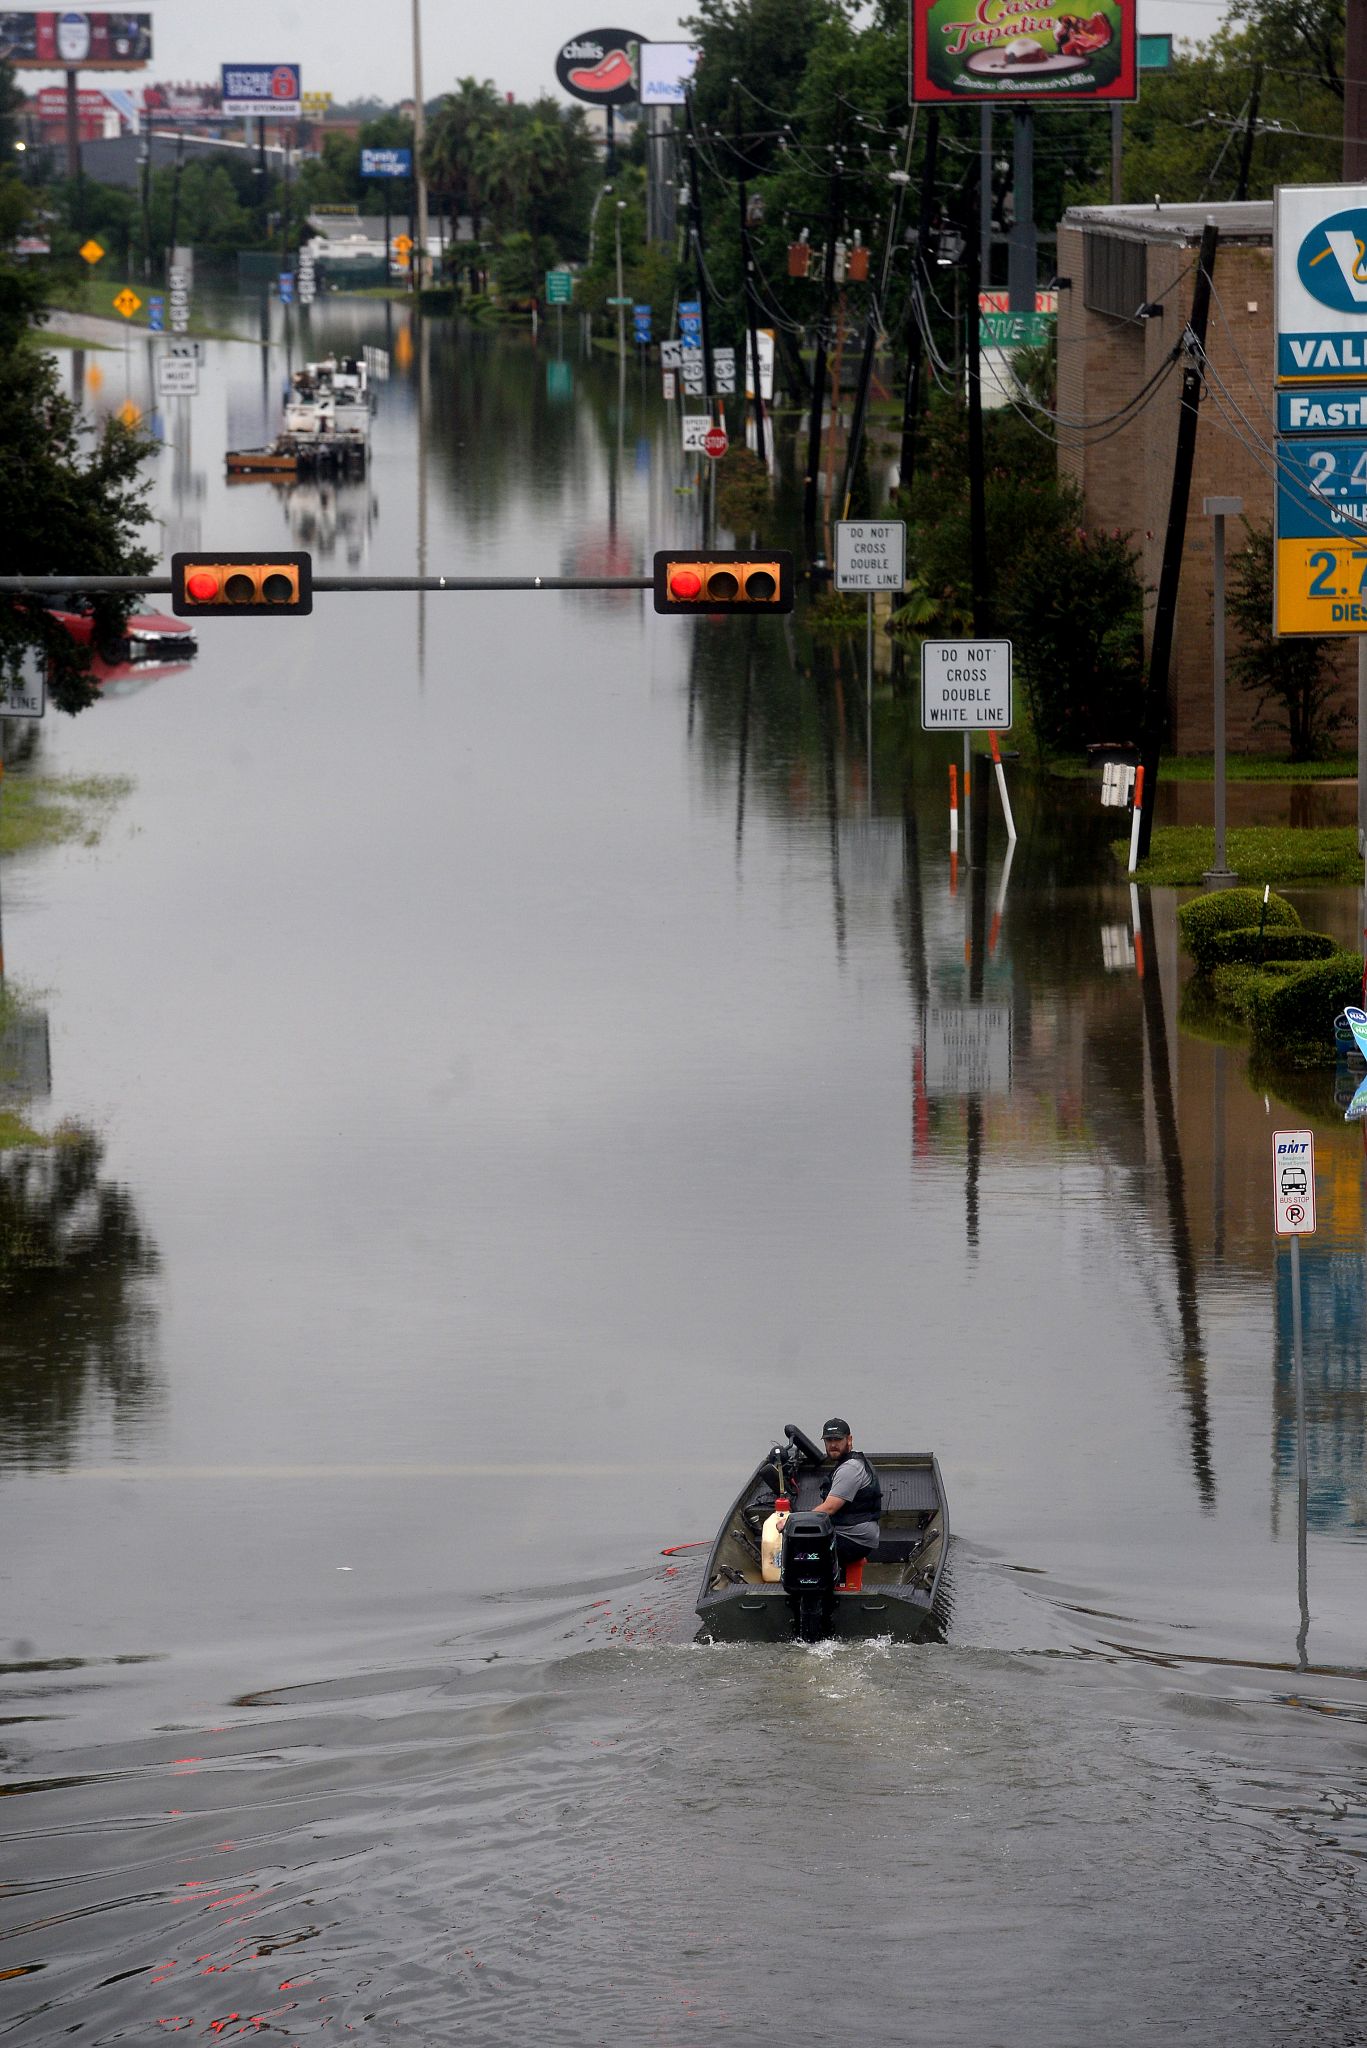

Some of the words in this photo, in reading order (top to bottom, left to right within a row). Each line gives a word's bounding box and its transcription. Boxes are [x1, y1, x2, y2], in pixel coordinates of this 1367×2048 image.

[976, 0, 1055, 24] Casa
[941, 16, 1055, 54] Tapatia
[684, 319, 698, 331] 10
[1289, 339, 1367, 368] VAL
[685, 364, 702, 376] 90
[717, 362, 734, 375] 69
[1290, 396, 1367, 427] FAST
[686, 433, 707, 447] 40
[706, 436, 726, 448] STOP
[850, 528, 864, 538] DO
[871, 528, 890, 538] NOT
[854, 543, 886, 553] CROSS
[850, 559, 889, 569] DOUBLE
[841, 574, 869, 584] WHITE
[877, 574, 898, 584] LINE
[941, 649, 957, 662] DO
[967, 649, 991, 661] NOT
[947, 669, 987, 681] CROSS
[942, 689, 991, 701] DOUBLE
[10, 696, 38, 710] LINE
[930, 708, 967, 721] WHITE
[976, 708, 1004, 721] LINE
[1277, 1144, 1308, 1154] BMT
